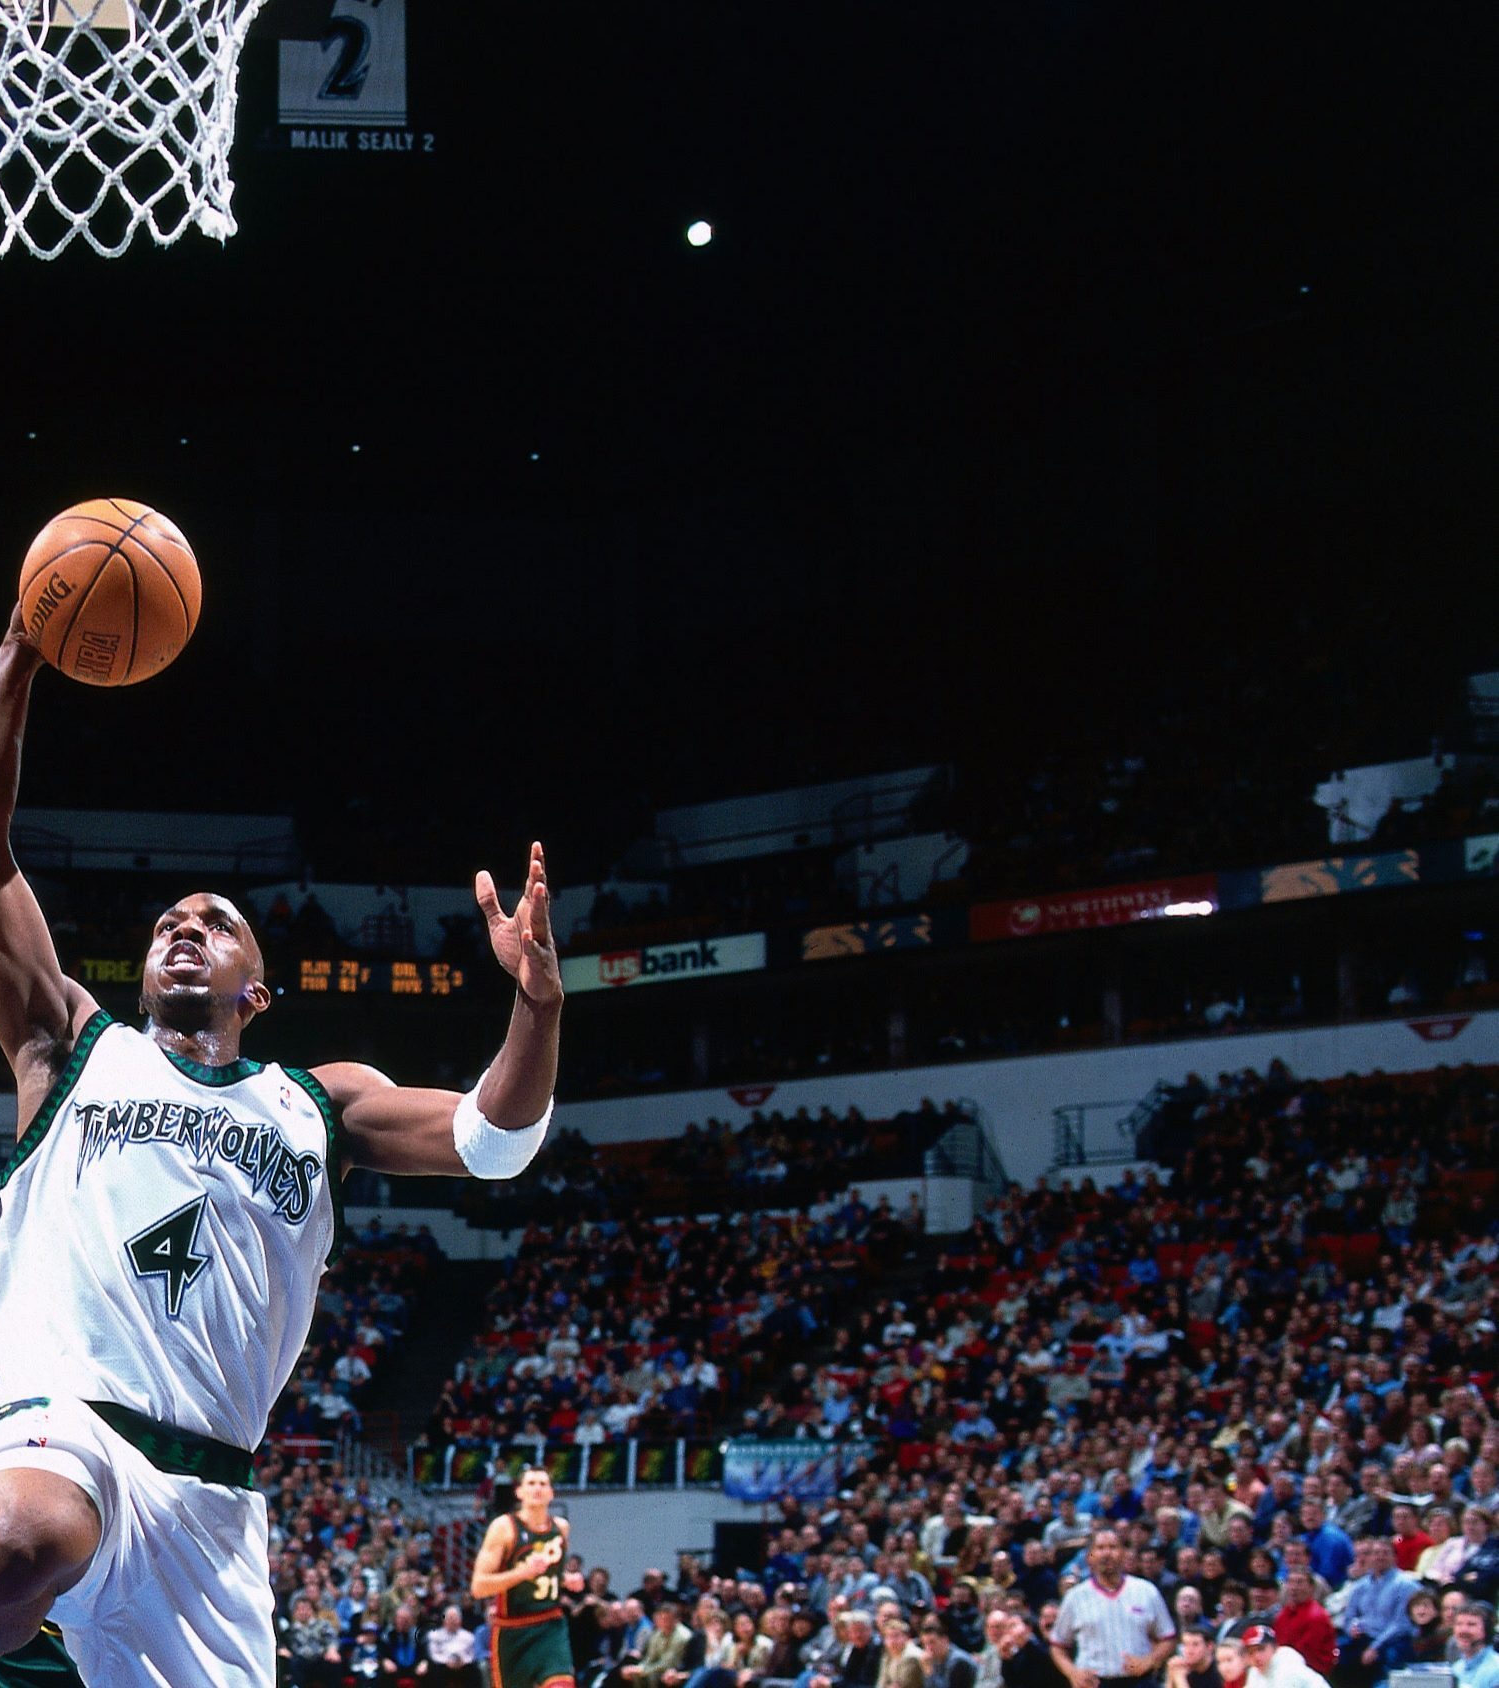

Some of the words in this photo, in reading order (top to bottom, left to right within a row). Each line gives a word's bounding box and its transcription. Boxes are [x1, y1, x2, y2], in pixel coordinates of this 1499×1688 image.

[318, 15, 371, 100] 2
[290, 129, 348, 149] MALIK
[358, 131, 415, 150] SEALY
[422, 132, 436, 152] 2
[74, 631, 121, 681] NBA
[74, 1098, 323, 1225] TIMBERWOLVES
[124, 1193, 212, 1320] 4
[533, 1575, 559, 1600] 31
